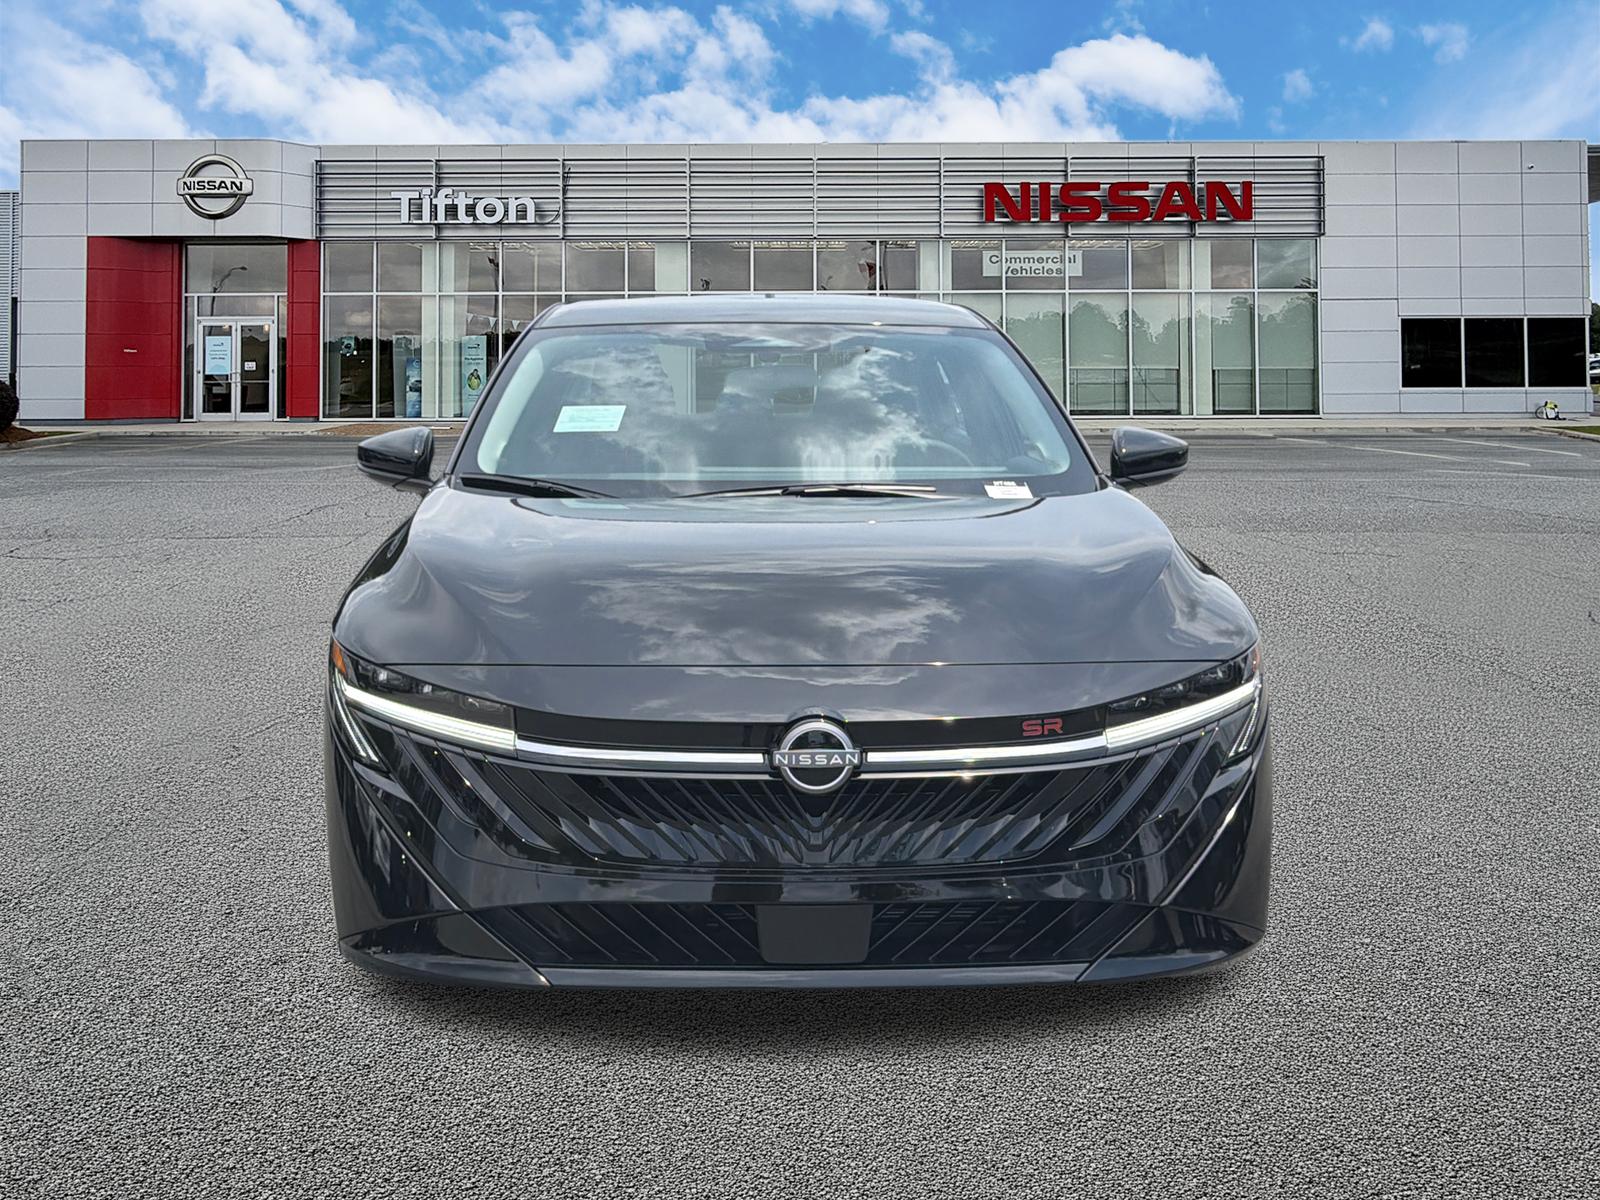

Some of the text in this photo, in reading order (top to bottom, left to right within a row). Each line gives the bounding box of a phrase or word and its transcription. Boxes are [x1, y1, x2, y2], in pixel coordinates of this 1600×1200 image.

[182, 180, 243, 191] NISSAN
[390, 188, 536, 224] Tifton
[983, 180, 1253, 222] NISSAN
[1022, 718, 1063, 736] SR
[775, 753, 859, 765] NISSAN
